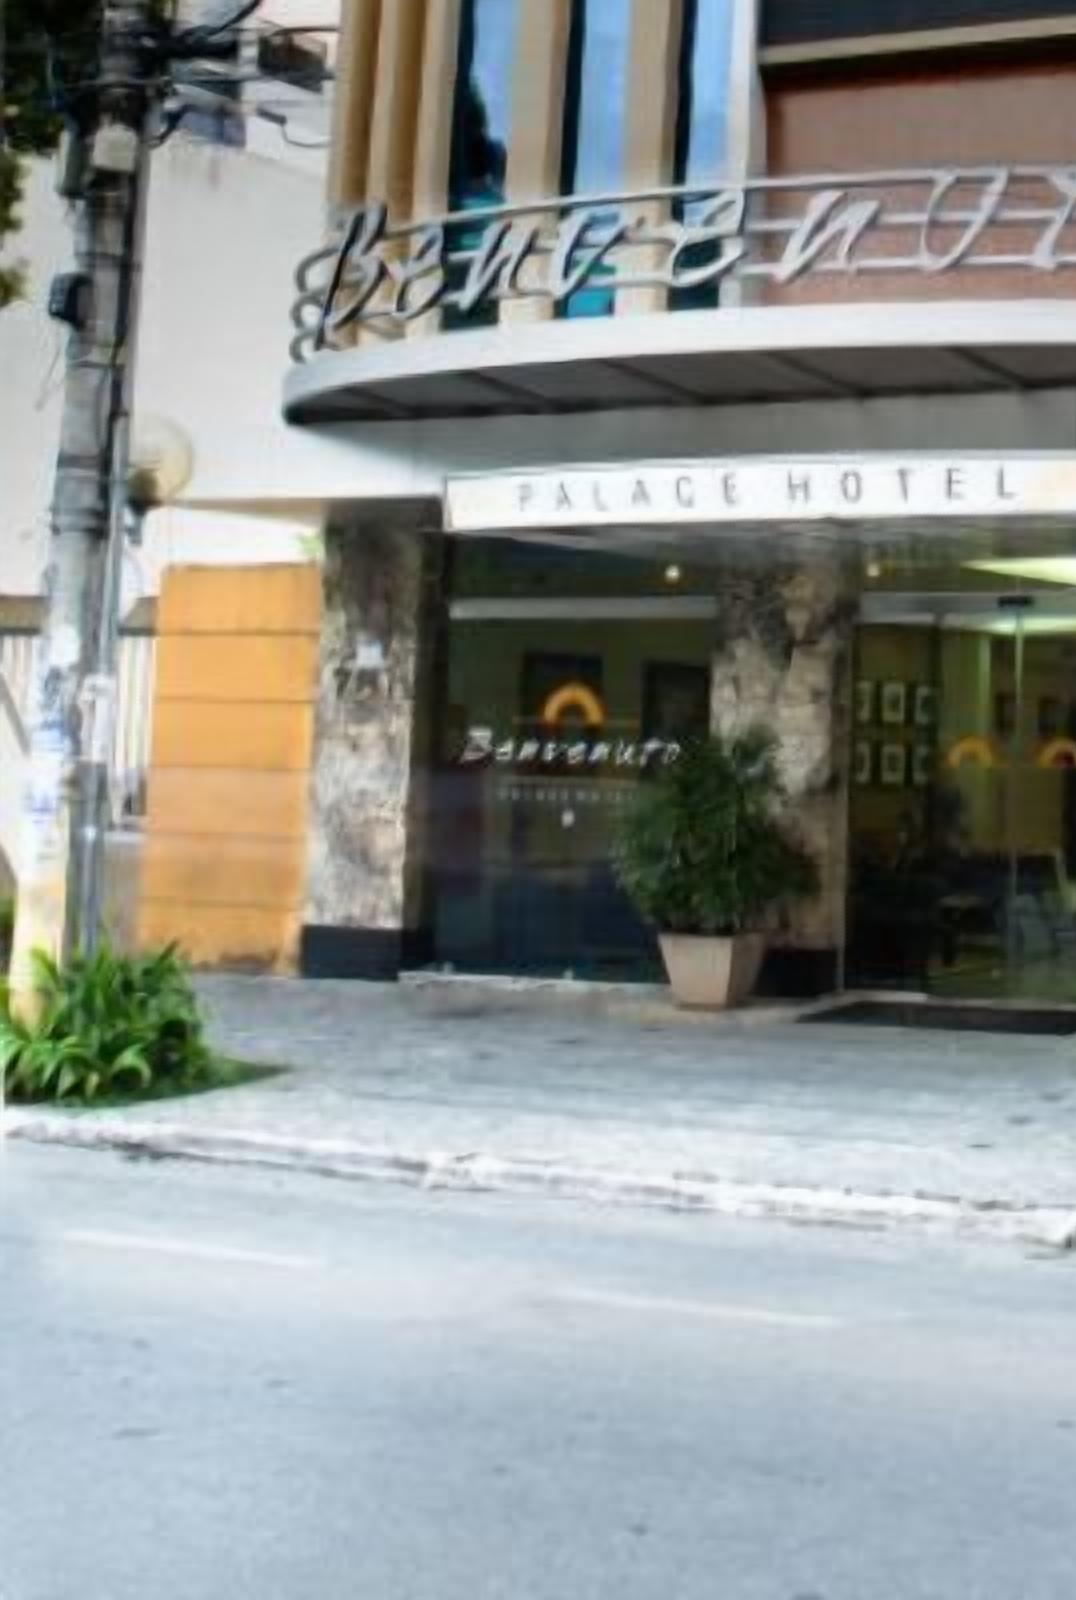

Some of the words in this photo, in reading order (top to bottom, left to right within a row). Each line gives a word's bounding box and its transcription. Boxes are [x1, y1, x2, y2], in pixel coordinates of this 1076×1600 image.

[518, 472, 738, 513] PALACE
[788, 466, 1018, 502] HOTEL
[458, 725, 681, 765] Benvenuto
